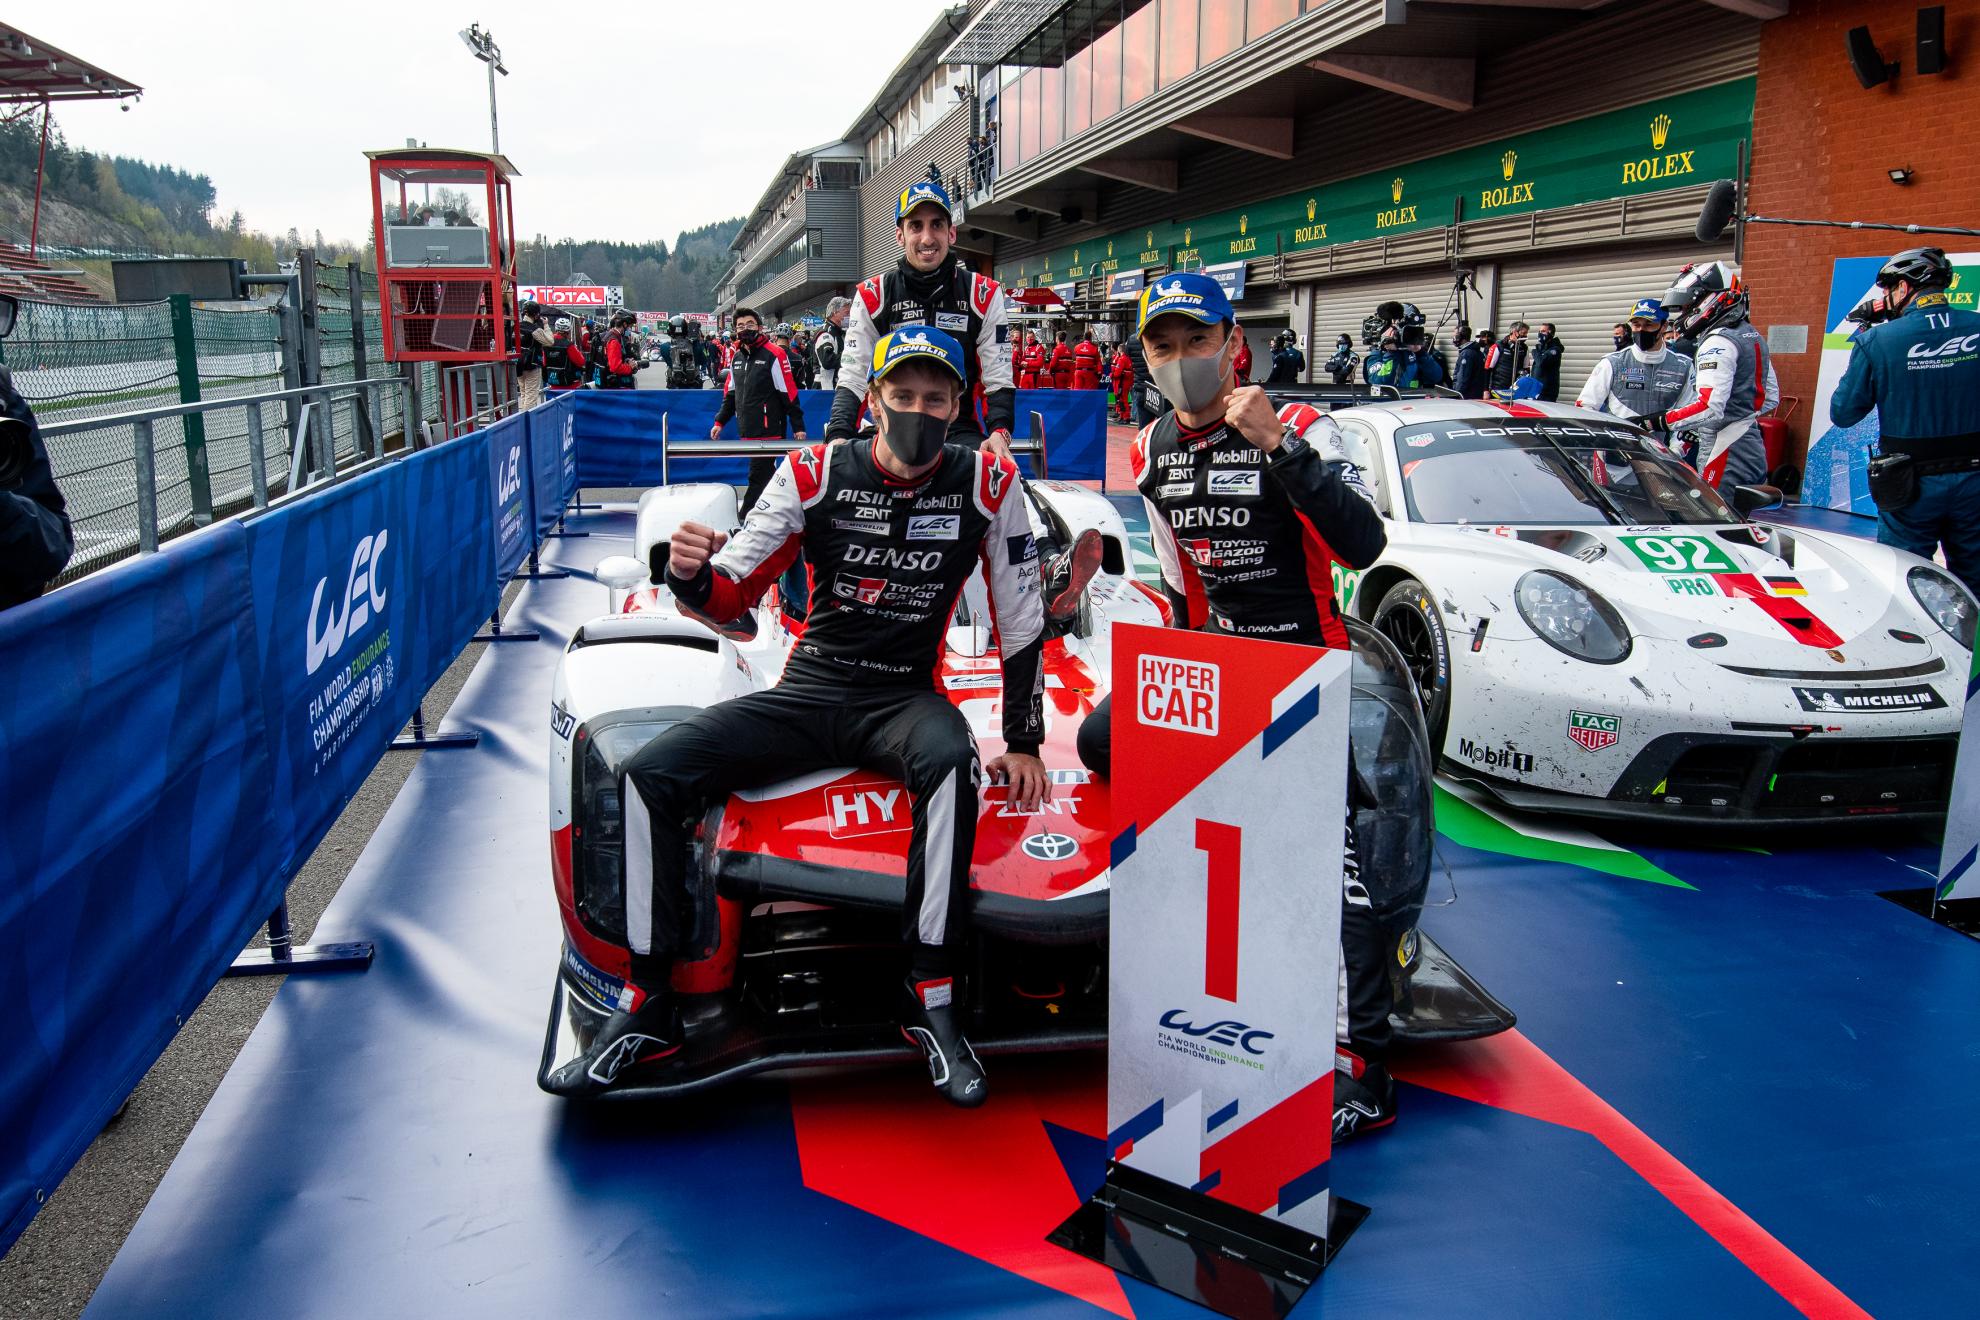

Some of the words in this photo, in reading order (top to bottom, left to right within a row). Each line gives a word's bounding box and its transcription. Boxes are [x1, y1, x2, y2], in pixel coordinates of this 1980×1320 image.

[1622, 150, 1694, 184] ROLEX
[907, 190, 943, 203] MICHELIN
[1481, 182, 1534, 209] ROLEX
[1376, 205, 1417, 228] ROLEX
[1295, 224, 1327, 243] ROLEX
[1230, 238, 1256, 254] ROLEX
[1140, 250, 1159, 264] ROLEX
[1177, 249, 1199, 263] ROLEX
[1069, 266, 1084, 278] ROLEX
[538, 289, 603, 304] TOTAL
[1010, 288, 1024, 298] 20
[1945, 292, 1974, 304] LEX
[1147, 297, 1203, 314] MICHELIN
[902, 309, 925, 320] ZENT
[937, 315, 967, 324] WEC
[1925, 312, 1950, 330] TV
[888, 344, 948, 360] MICHELIN
[1907, 333, 1980, 358] WEC
[1908, 362, 1954, 370] CHAMPIONSHIP
[1942, 354, 1978, 364] ENDURANCE
[1146, 387, 1160, 406] BOSS
[1446, 428, 1638, 442] PORSCHE
[1212, 449, 1248, 464] Mobil
[498, 446, 520, 506] WEC
[1168, 468, 1196, 480] ZENT
[1211, 474, 1256, 484] WEC
[855, 506, 892, 520] ZENT
[1170, 506, 1251, 529] DENSO
[848, 522, 886, 531] MICHELIN
[911, 518, 956, 530] WEC
[1212, 540, 1270, 549] TOYOTA
[1212, 546, 1265, 558] GAZOO
[843, 544, 943, 572] DENSO
[1212, 556, 1264, 568] Racing
[1635, 538, 1729, 571] 92
[1217, 568, 1278, 584] HYBRID
[836, 582, 880, 602] GR
[1331, 566, 1361, 616] 92
[1667, 577, 1715, 596] PRO
[306, 528, 388, 676] WEC
[885, 592, 936, 600] GAOO
[1248, 622, 1299, 632] NAKAJIMA
[1429, 614, 1446, 679] MICHELIN
[310, 696, 324, 724] FIA
[324, 666, 352, 712] WORLD
[352, 628, 390, 679] ENDURANCE
[1142, 659, 1214, 692] HYPER
[1142, 683, 1214, 730] CAR
[1844, 692, 1932, 706] MICHELIN
[313, 676, 370, 751] CHAMPIONSHIP
[1575, 714, 1615, 730] TAG
[314, 761, 320, 776] A
[322, 704, 371, 767] PARTNERSHIP
[1572, 728, 1614, 750] HEUER
[1459, 738, 1508, 768] Mobil
[832, 790, 900, 828] HY
[1195, 818, 1242, 1004] 1
[568, 952, 621, 998] MICHELIN
[1158, 1008, 1275, 1055] WEC
[1158, 1032, 1172, 1042] FIA
[1174, 1036, 1207, 1052] WORLD
[1208, 1048, 1264, 1071] ENDURANCE
[1158, 1040, 1226, 1065] CHAMPIONSHIP
